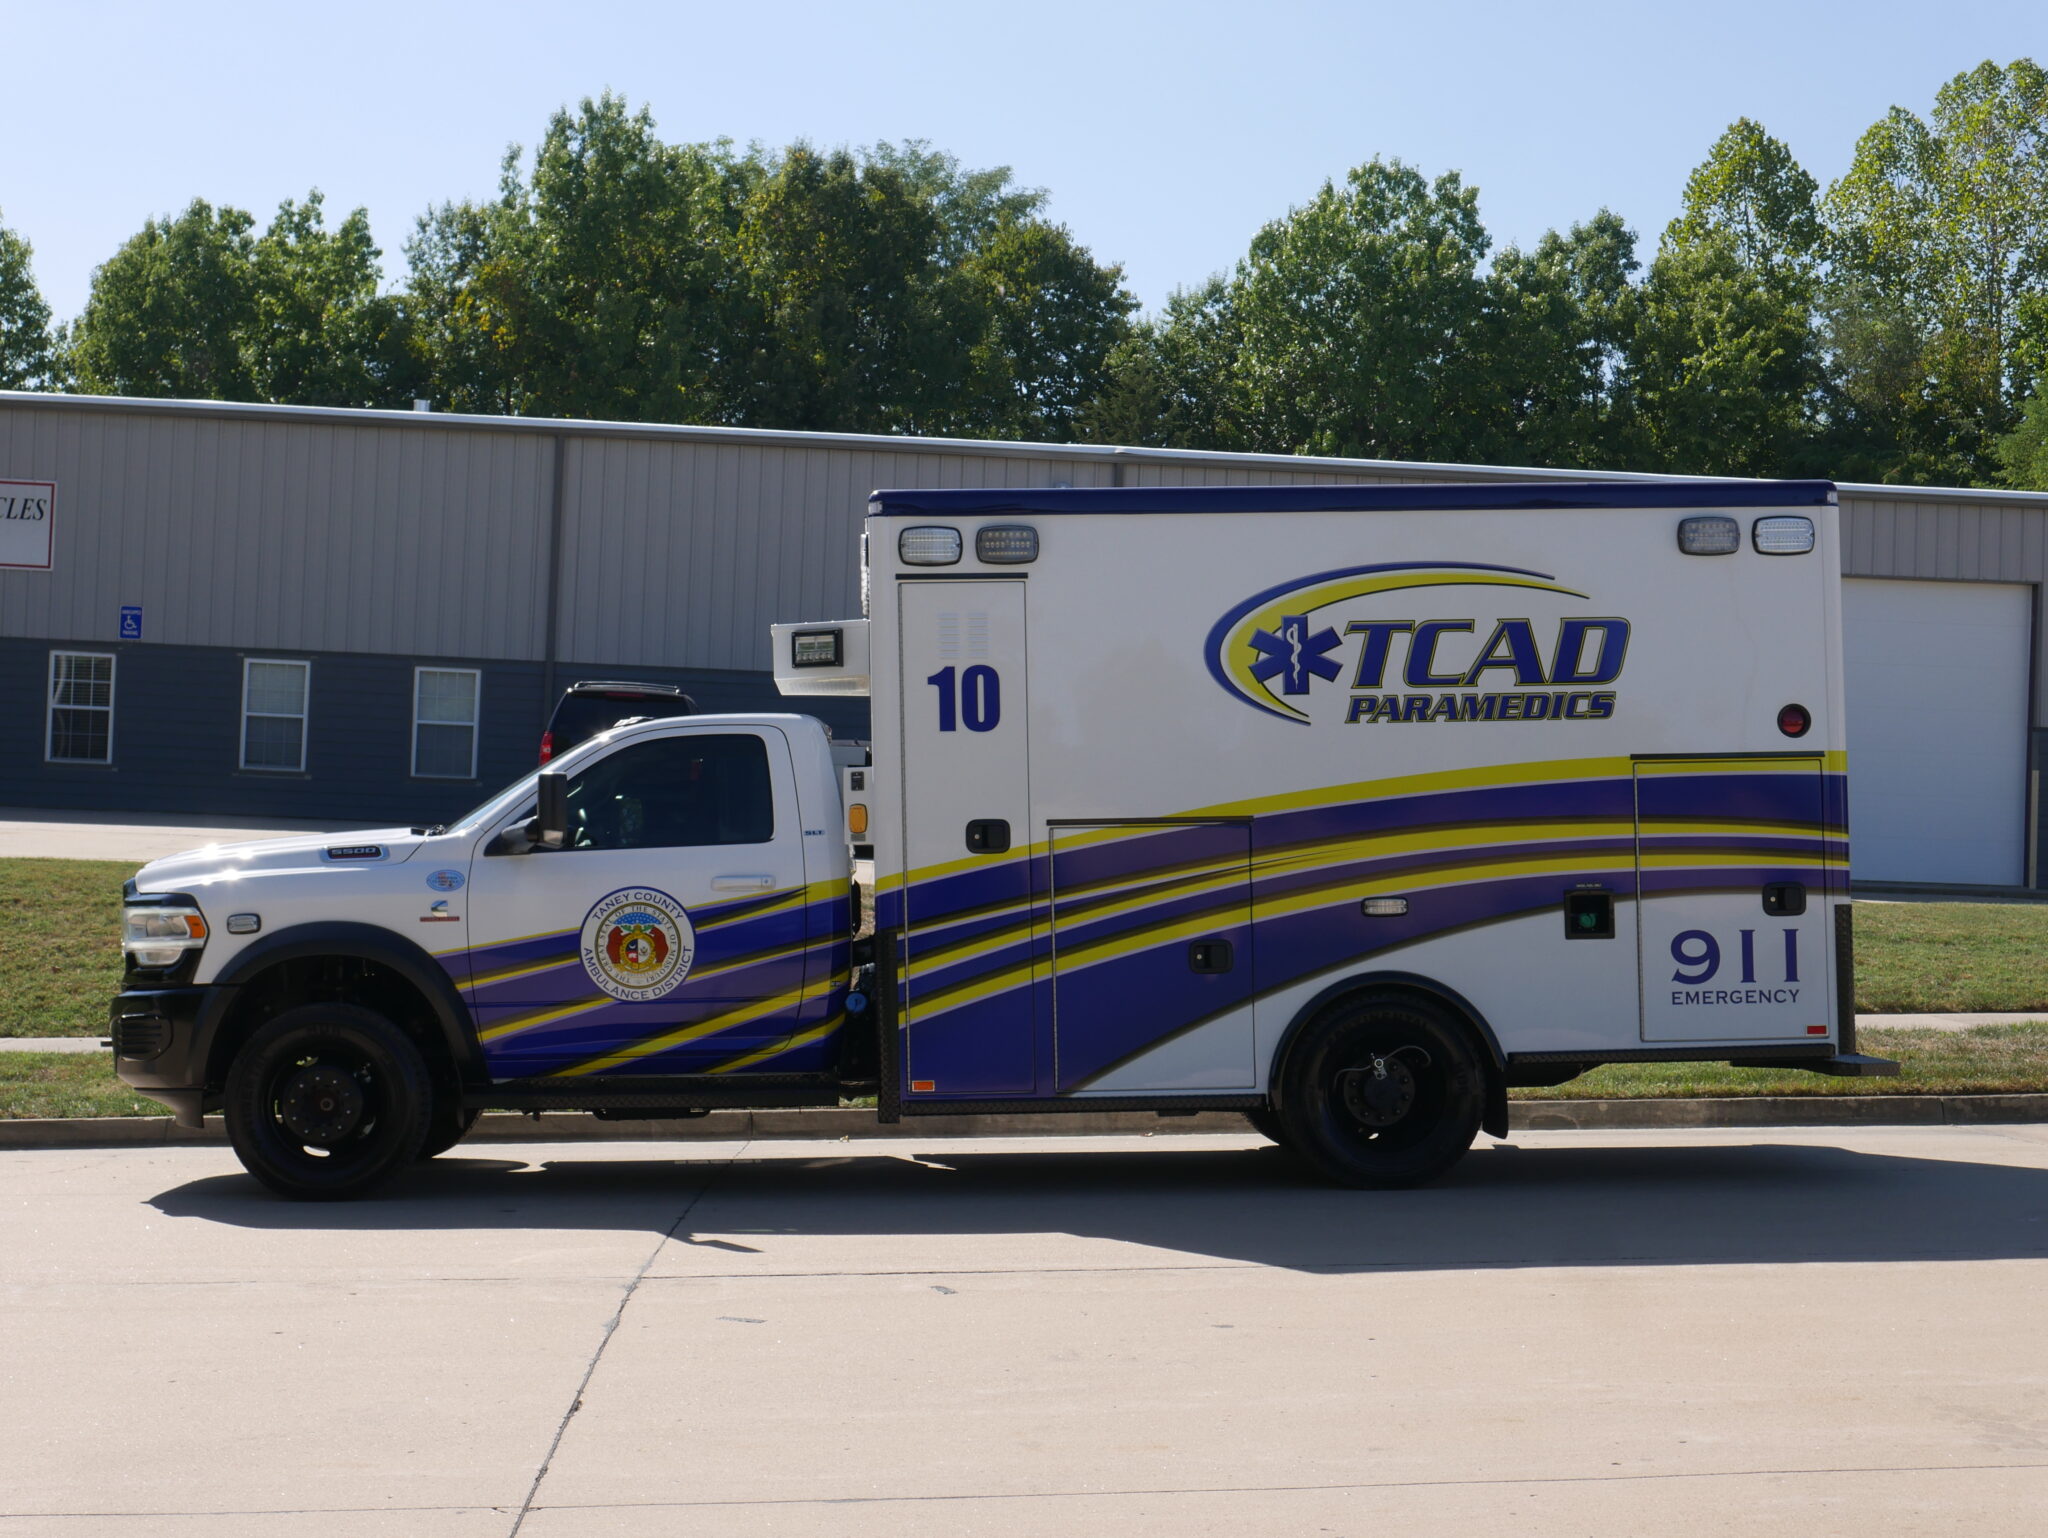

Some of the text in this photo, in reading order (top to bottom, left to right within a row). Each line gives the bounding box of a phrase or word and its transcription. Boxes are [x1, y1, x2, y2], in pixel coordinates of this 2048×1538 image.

[1344, 617, 1631, 689] TCAD
[927, 664, 1000, 732] 10
[1344, 691, 1617, 725] PARAMEDICS
[592, 892, 683, 920] TANEY COUNTY
[583, 945, 692, 1000] AMBULANCE DISTRICT
[1670, 929, 1800, 985] 911
[1671, 989, 1800, 1005] EMERGENCY
